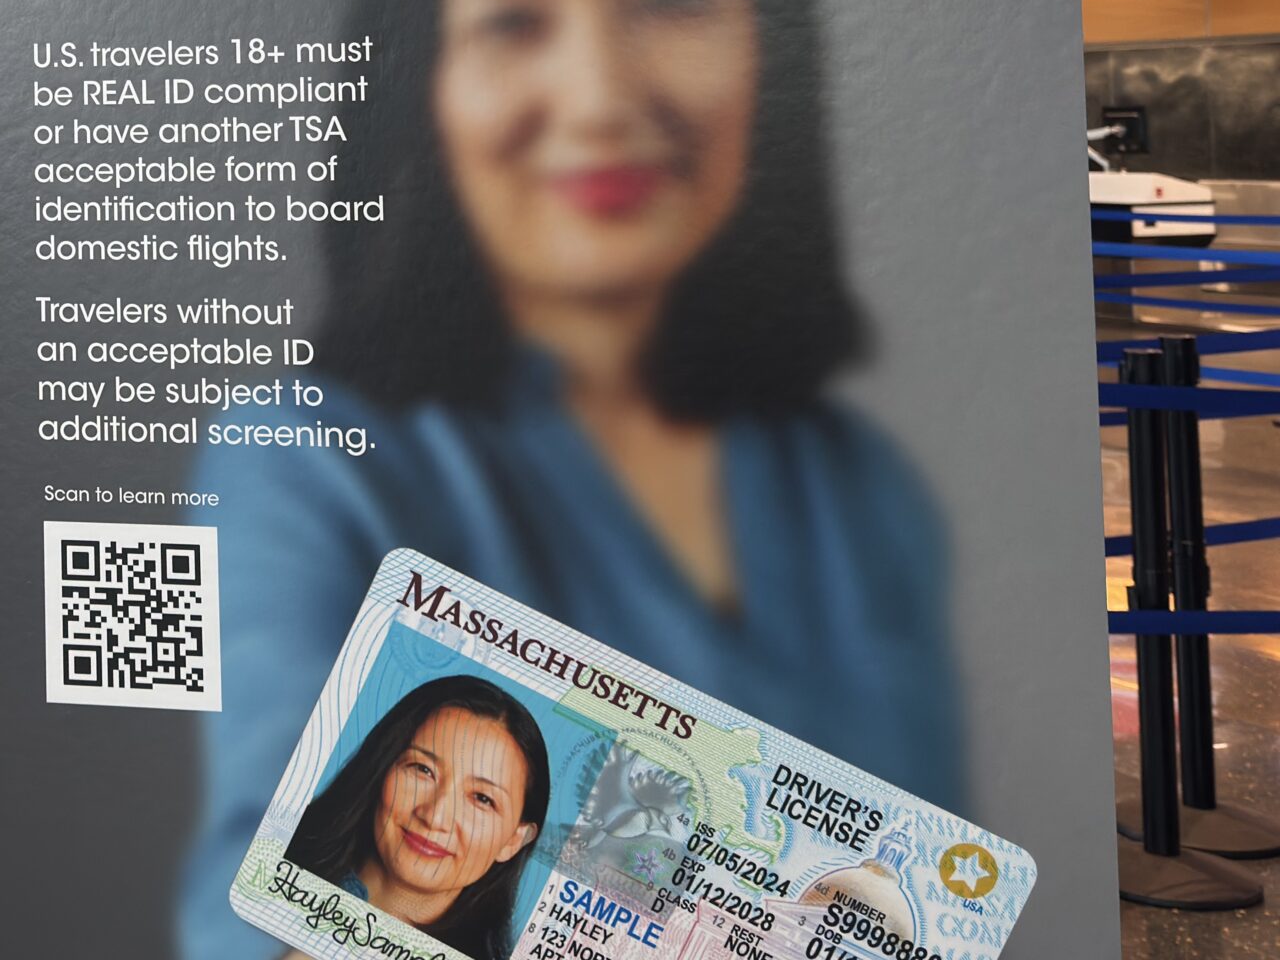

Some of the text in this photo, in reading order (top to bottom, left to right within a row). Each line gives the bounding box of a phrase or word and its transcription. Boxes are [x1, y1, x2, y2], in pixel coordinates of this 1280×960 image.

[33, 35, 373, 69] U.S. travelers 18+ must
[33, 75, 369, 109] be REAL ID compliant
[33, 115, 347, 145] or have another TSA
[34, 154, 338, 189] acceptable form of
[35, 195, 384, 222] identification to board
[35, 234, 287, 269] domestic flights.
[35, 296, 294, 325] Travelers without
[37, 337, 314, 370] an acceptable ID
[38, 376, 324, 411] may be subject to
[38, 414, 376, 456] additional screening.
[44, 485, 220, 506] Scan to learn more
[396, 569, 698, 740] MASSACHUSETTS
[771, 764, 884, 831] DRIVER'S
[695, 821, 716, 838] ISS
[765, 787, 870, 852] LICENSE
[680, 856, 706, 874] EXP
[686, 833, 791, 898] 07/05/2024
[268, 860, 358, 945] Hayley
[350, 912, 446, 960] Sam
[559, 880, 665, 949] SAMPLE
[651, 897, 665, 914] D
[657, 887, 697, 914] CLASS
[671, 868, 776, 932] 01/12/2028
[832, 890, 887, 925] NUMBER
[963, 898, 984, 916] USA
[541, 926, 567, 949] 123
[549, 903, 614, 945] HAYLEY
[712, 915, 764, 947] 12 REST
[815, 924, 843, 945] DOB
[822, 903, 943, 960] S999888
